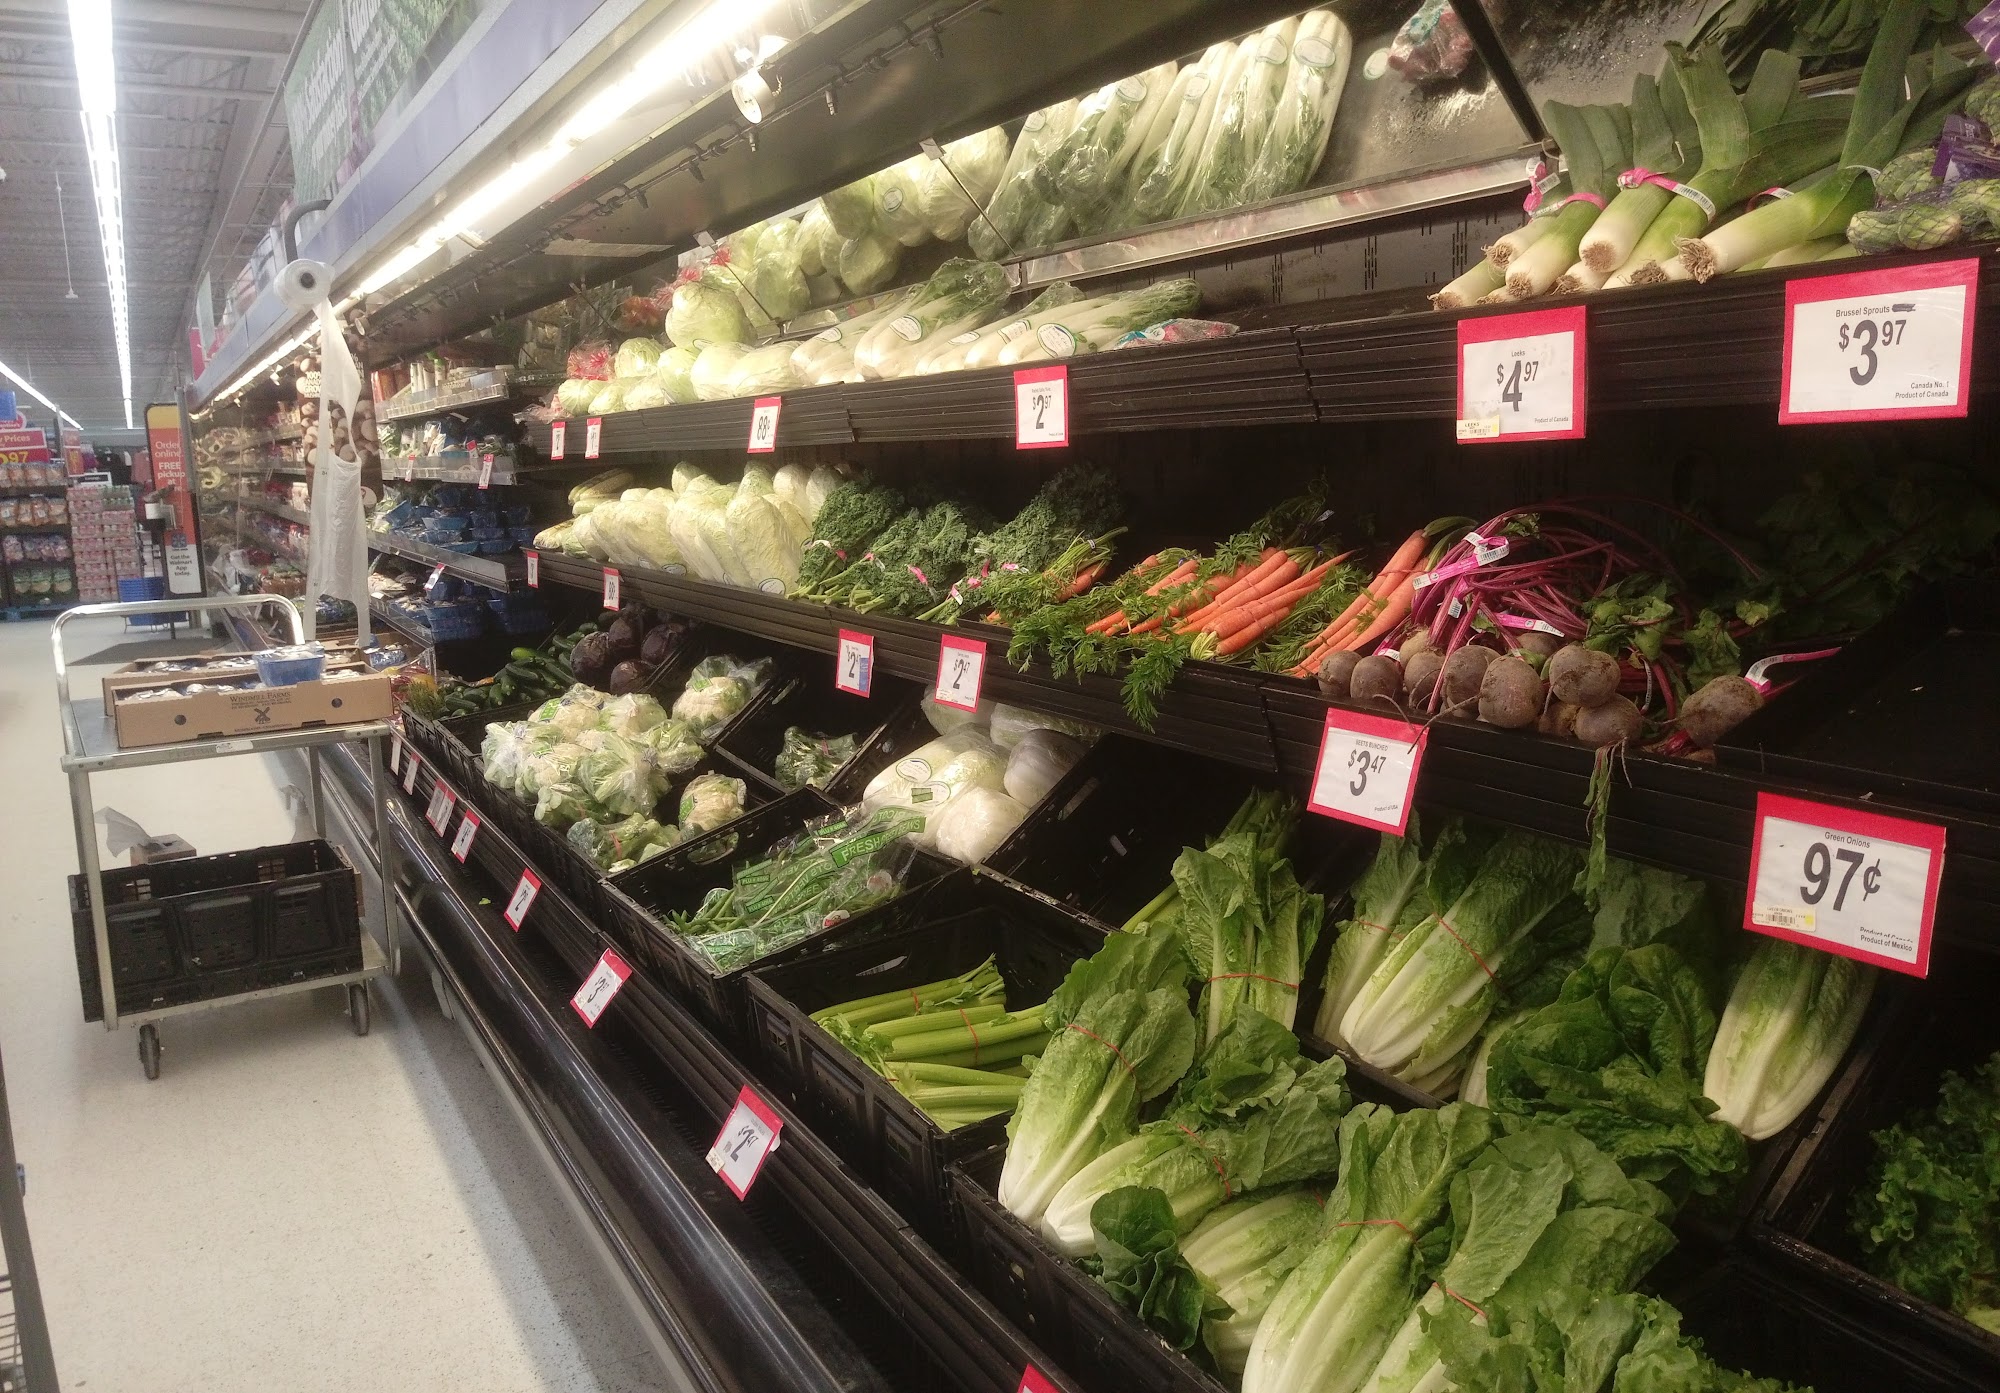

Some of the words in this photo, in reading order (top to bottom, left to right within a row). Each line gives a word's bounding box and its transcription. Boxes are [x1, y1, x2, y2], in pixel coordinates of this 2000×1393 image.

[1836, 307, 1862, 318] Brussel
[1863, 305, 1890, 316] Sprouts
[1910, 381, 1933, 389] Canada
[1934, 380, 1945, 388] No.
[158, 462, 181, 470] FREE
[157, 470, 186, 480] pickup
[1824, 831, 1845, 844] Green
[1846, 836, 1871, 849] Onions
[841, 836, 883, 862] FRESH
[1860, 934, 1883, 946] Product
[1891, 941, 1913, 951] Mexico
